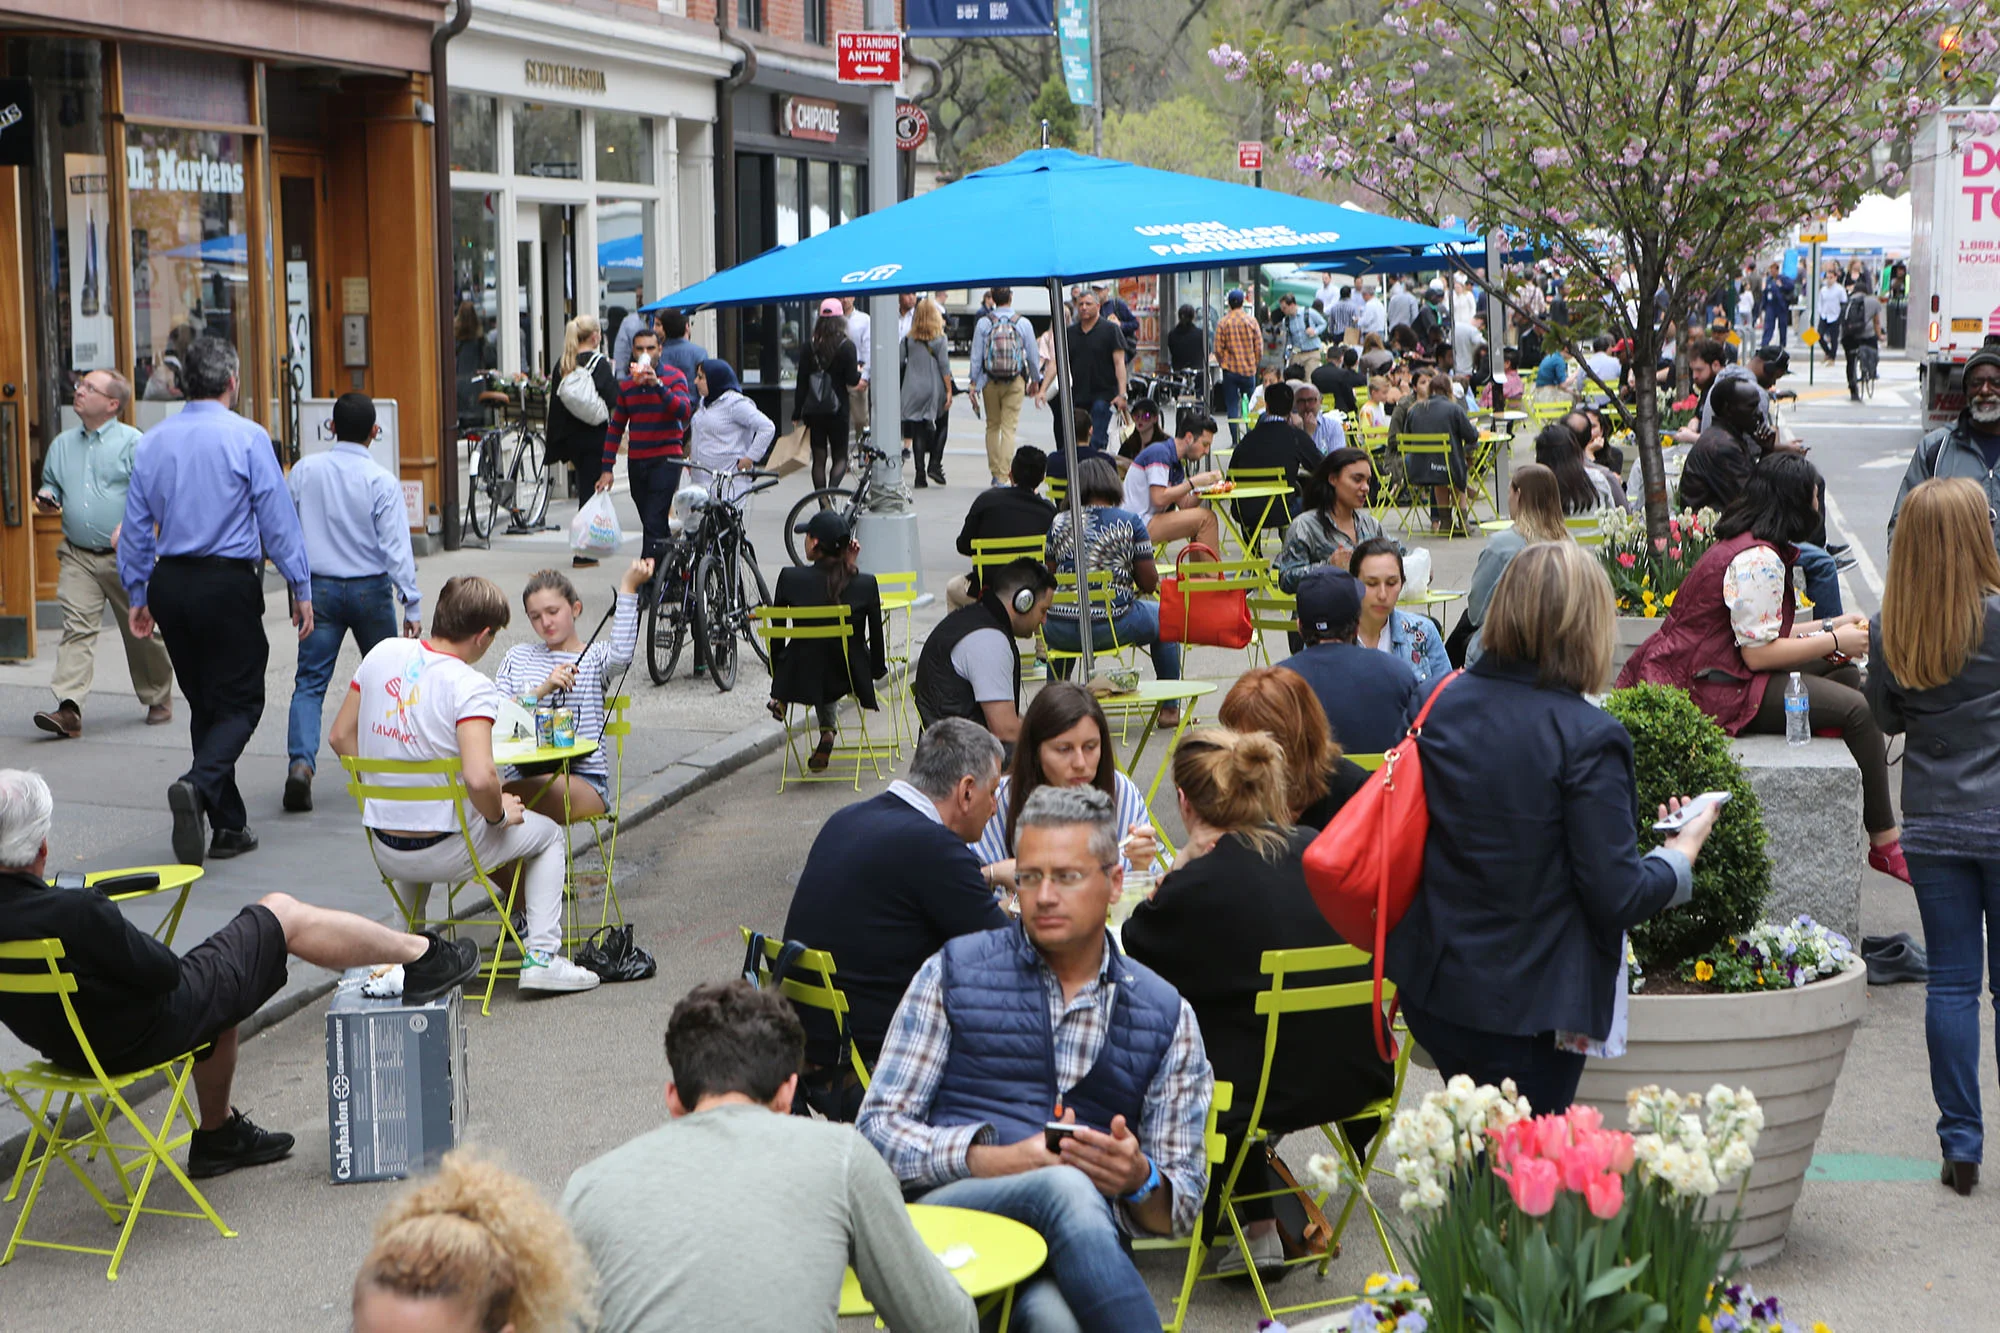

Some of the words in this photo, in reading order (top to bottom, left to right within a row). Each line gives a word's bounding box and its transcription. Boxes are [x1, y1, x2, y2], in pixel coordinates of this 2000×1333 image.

[840, 36, 853, 48] NO
[856, 36, 898, 49] STANDING
[847, 51, 892, 63] ANYTIME
[796, 104, 840, 133] CHIPOTLE
[896, 105, 927, 125] IPOTLE
[157, 148, 244, 193] Martens
[1963, 142, 2000, 177] D
[1962, 186, 2000, 222] T
[1134, 221, 1229, 236] UNION
[1181, 225, 1297, 243] SQUARE
[1149, 231, 1341, 256] PARTNERSHIP
[1958, 254, 2000, 264] HOUSI
[840, 264, 903, 283] citi
[371, 721, 419, 745] LAWRNCE
[336, 1100, 353, 1180] Calphalon
